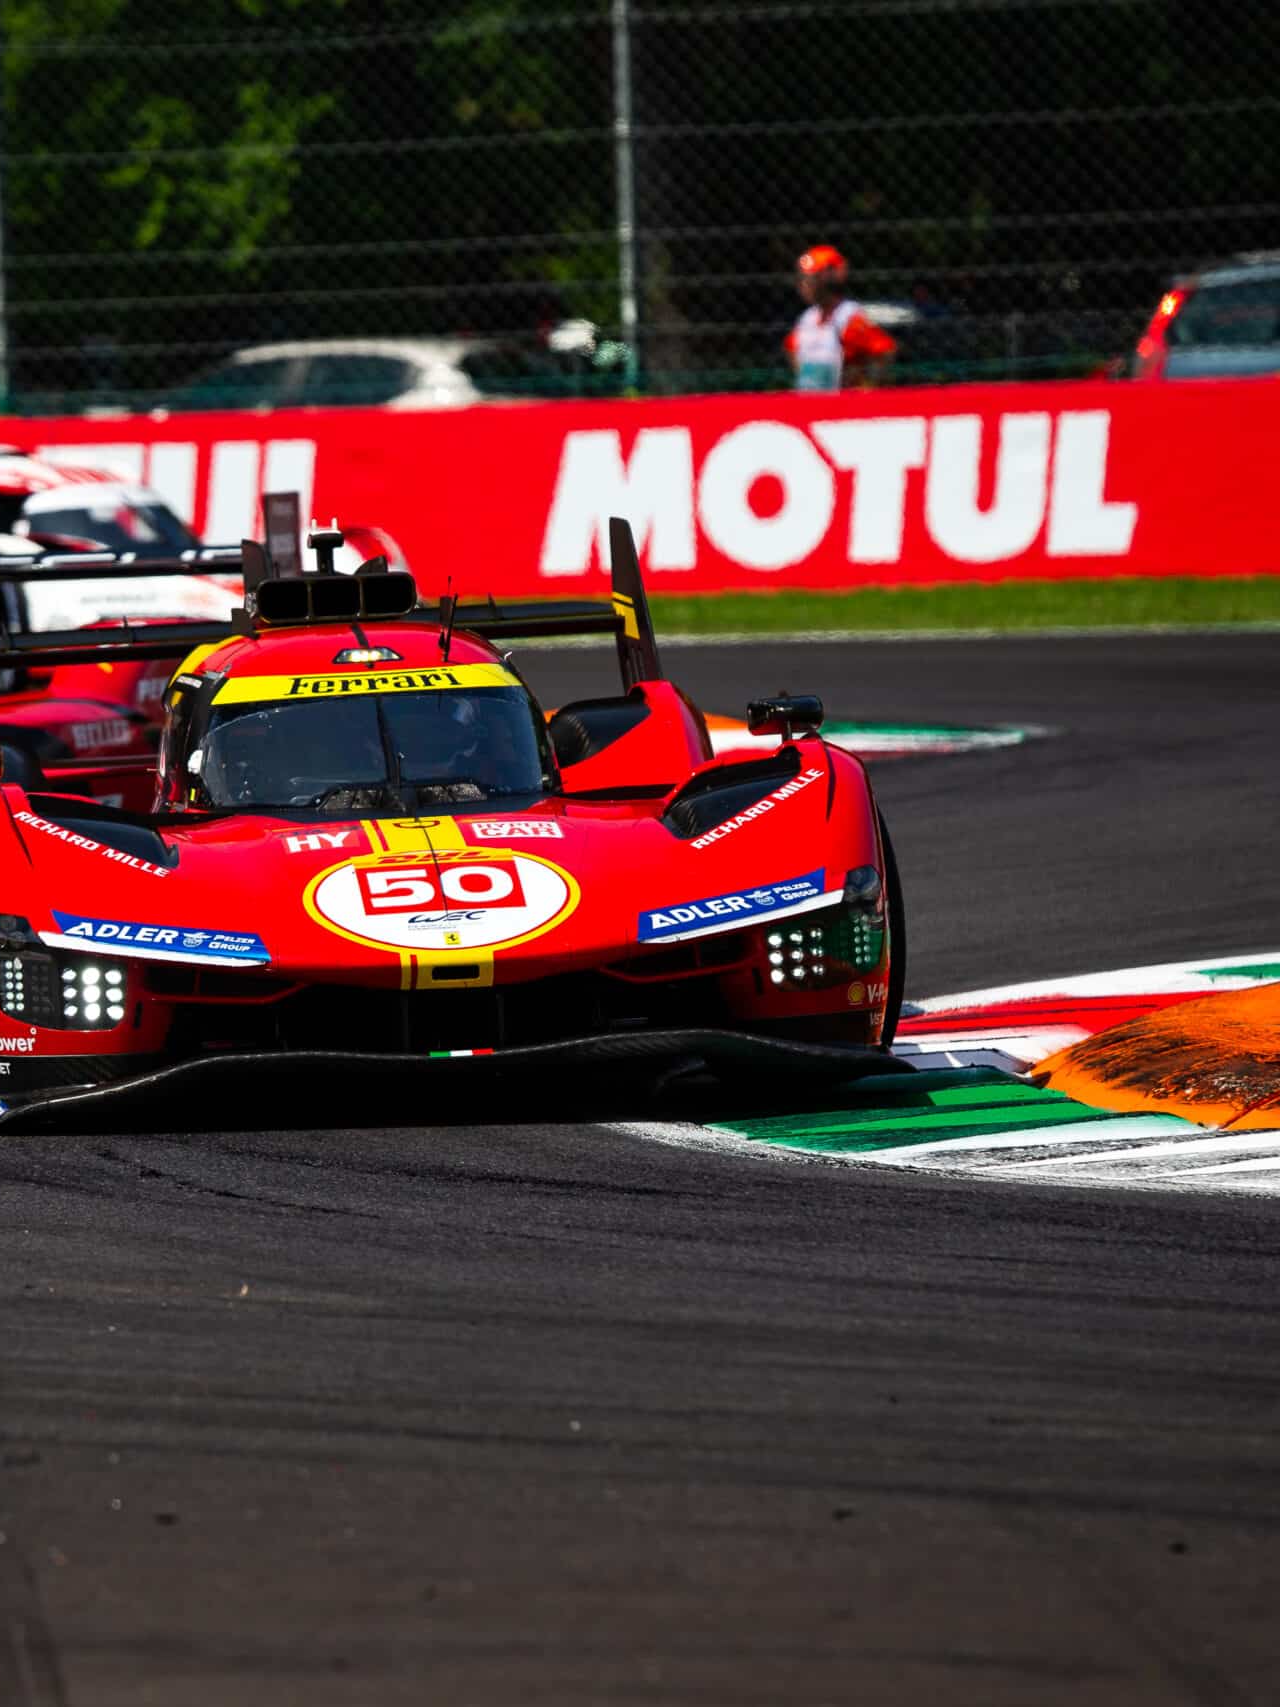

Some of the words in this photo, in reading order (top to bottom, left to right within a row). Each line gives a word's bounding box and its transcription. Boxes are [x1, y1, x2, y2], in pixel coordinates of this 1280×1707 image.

[538, 408, 1139, 579] MOTUL
[284, 668, 463, 697] Ferrari
[688, 799, 777, 851] RICHARD
[771, 766, 826, 802] MILLE
[286, 829, 353, 854] HY
[477, 821, 555, 830] HYPER
[479, 829, 556, 838] CAR
[11, 809, 101, 853] RICHARD
[101, 846, 170, 879] MILLE
[365, 864, 515, 910] 50
[647, 894, 754, 931] ADLER
[63, 920, 179, 946] ADLER
